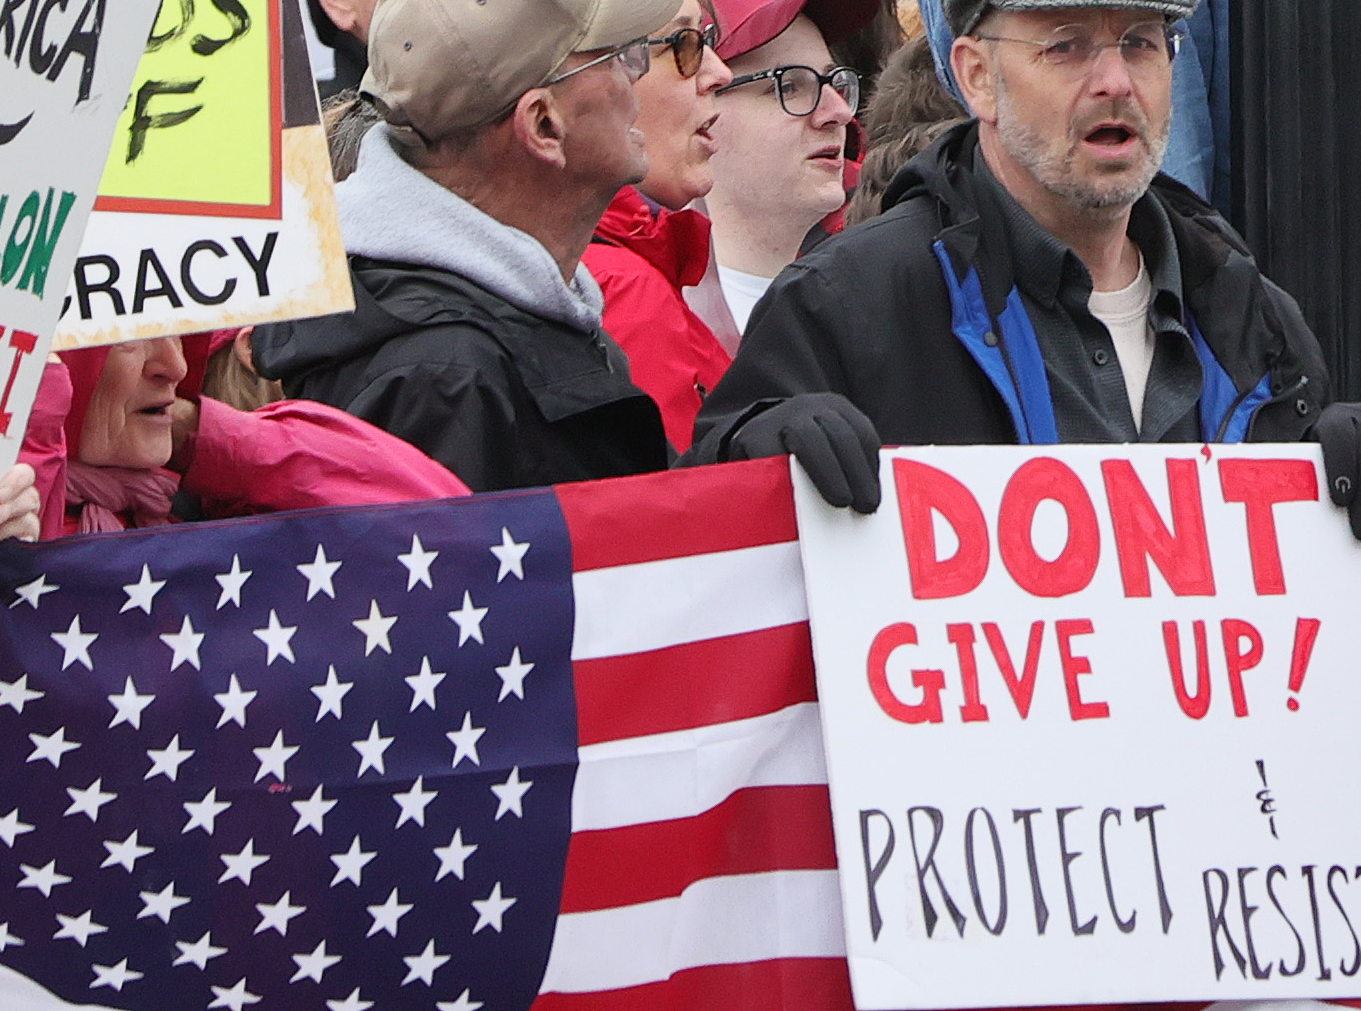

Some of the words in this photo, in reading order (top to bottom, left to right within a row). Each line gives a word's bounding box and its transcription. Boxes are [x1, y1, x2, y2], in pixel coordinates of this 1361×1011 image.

[892, 443, 1319, 600] DON'T
[867, 617, 1111, 725] GIVE
[1161, 617, 1322, 721] UP!
[858, 804, 1175, 943] PROTECT
